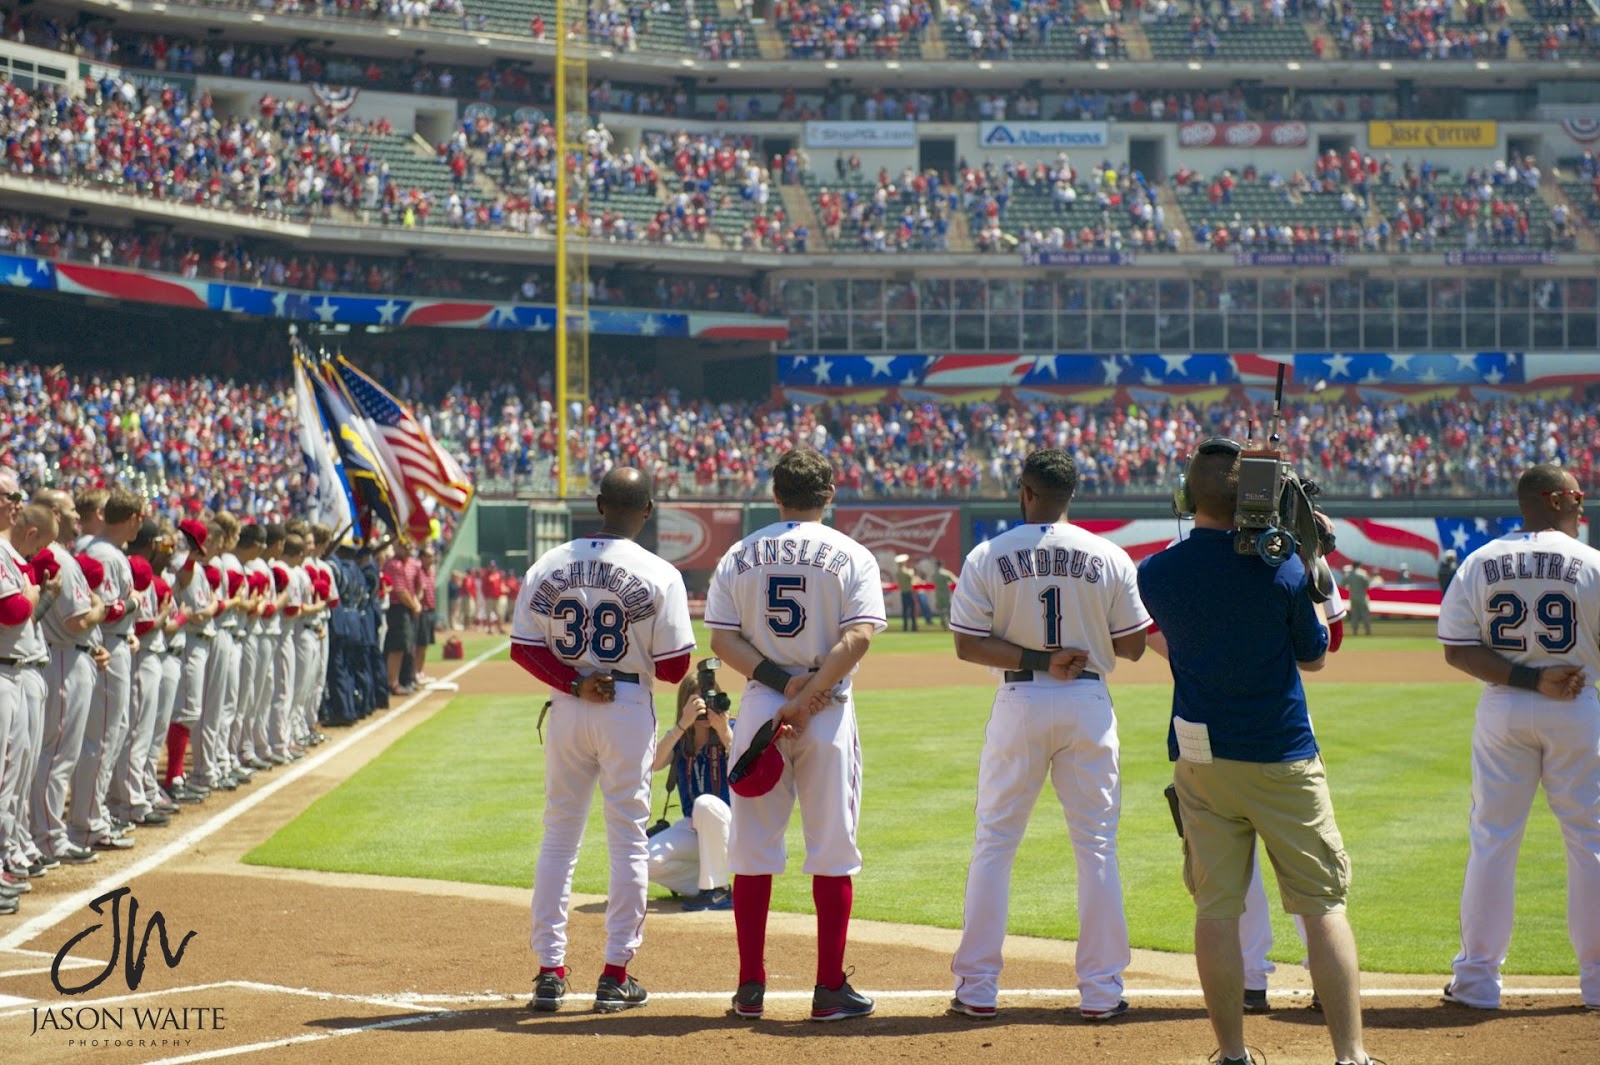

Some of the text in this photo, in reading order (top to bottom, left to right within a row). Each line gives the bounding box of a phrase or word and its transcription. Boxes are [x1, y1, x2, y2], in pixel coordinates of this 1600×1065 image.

[1018, 129, 1102, 145] Albertsons
[732, 538, 850, 576] KINSLER
[995, 548, 1105, 585] ANDRUS
[1482, 551, 1583, 585] BELTRE
[529, 560, 657, 624] WASHINGTON
[764, 574, 807, 638] 5
[1038, 585, 1063, 650] 1
[1486, 590, 1578, 654] 29
[551, 597, 631, 664] 38
